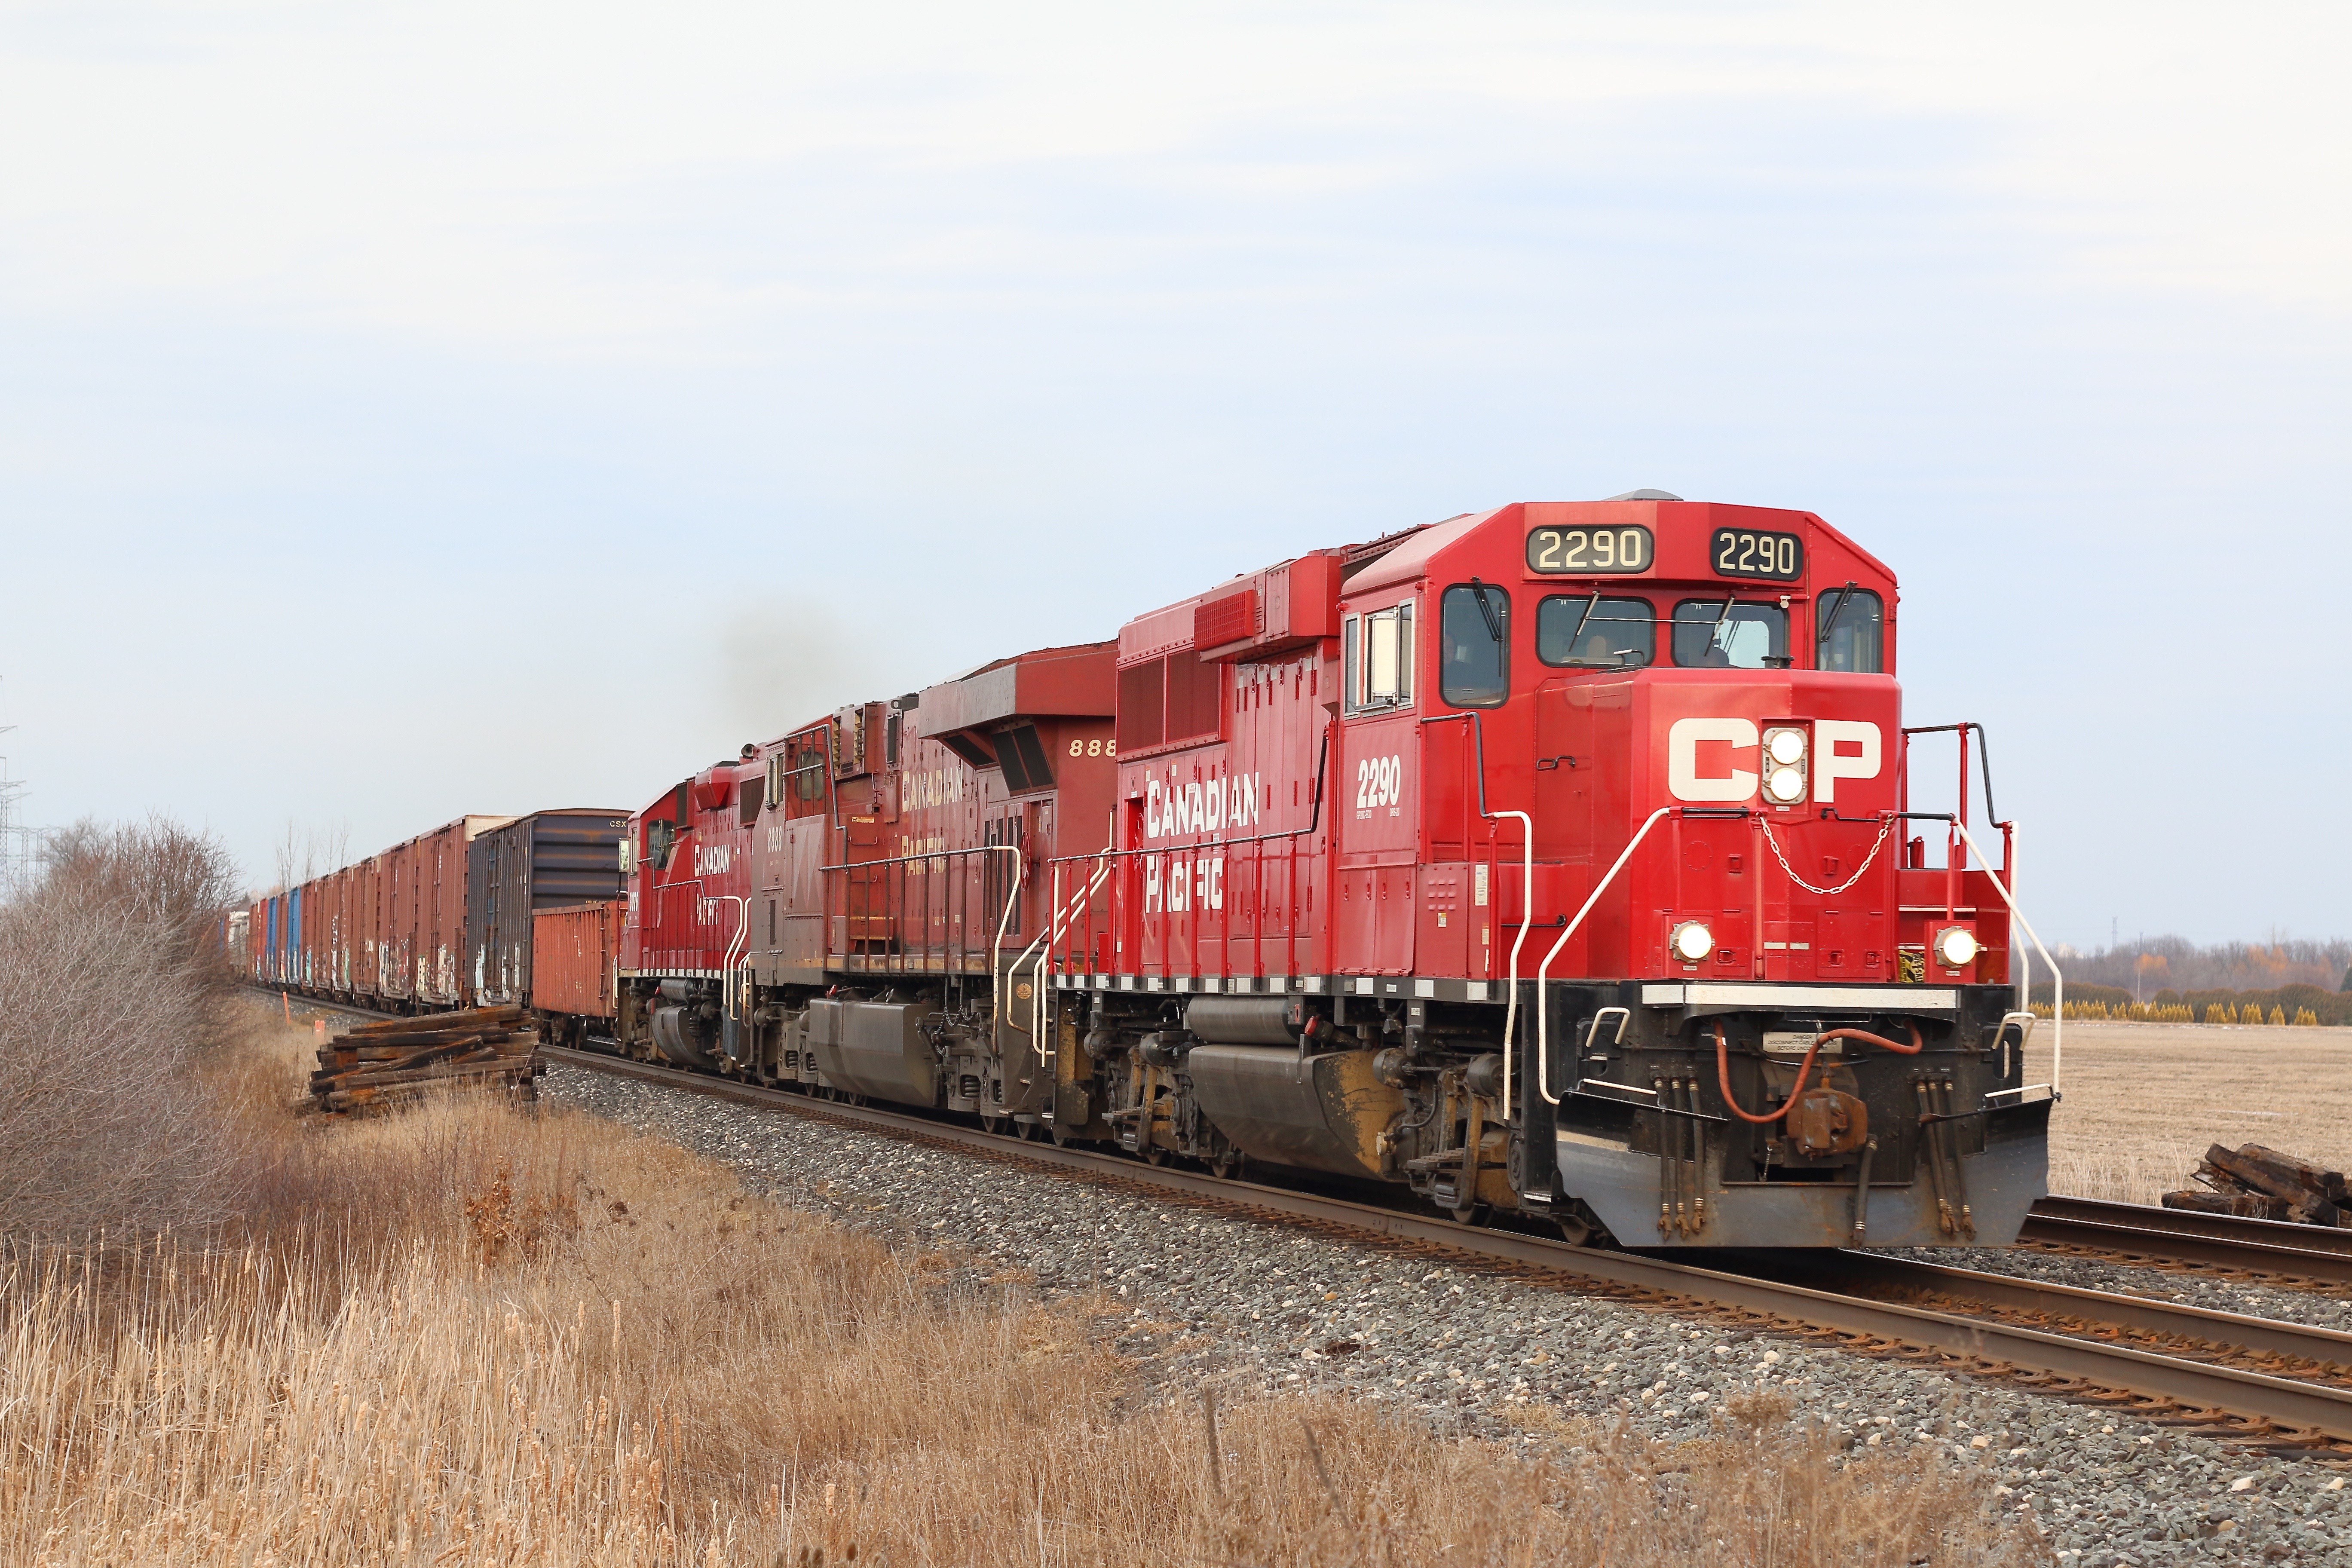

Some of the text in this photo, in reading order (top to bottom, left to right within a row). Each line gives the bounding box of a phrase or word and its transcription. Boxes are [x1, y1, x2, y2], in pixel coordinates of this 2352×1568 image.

[1538, 530, 1642, 569] 2290
[1719, 533, 1795, 575] 2290
[1356, 754, 1401, 809] 2290
[1668, 718, 1882, 803] CP
[902, 764, 963, 812] CANADIAN
[1147, 772, 1259, 839] CANADIAN
[694, 844, 729, 877] CANADIAN
[767, 826, 782, 853] 8888
